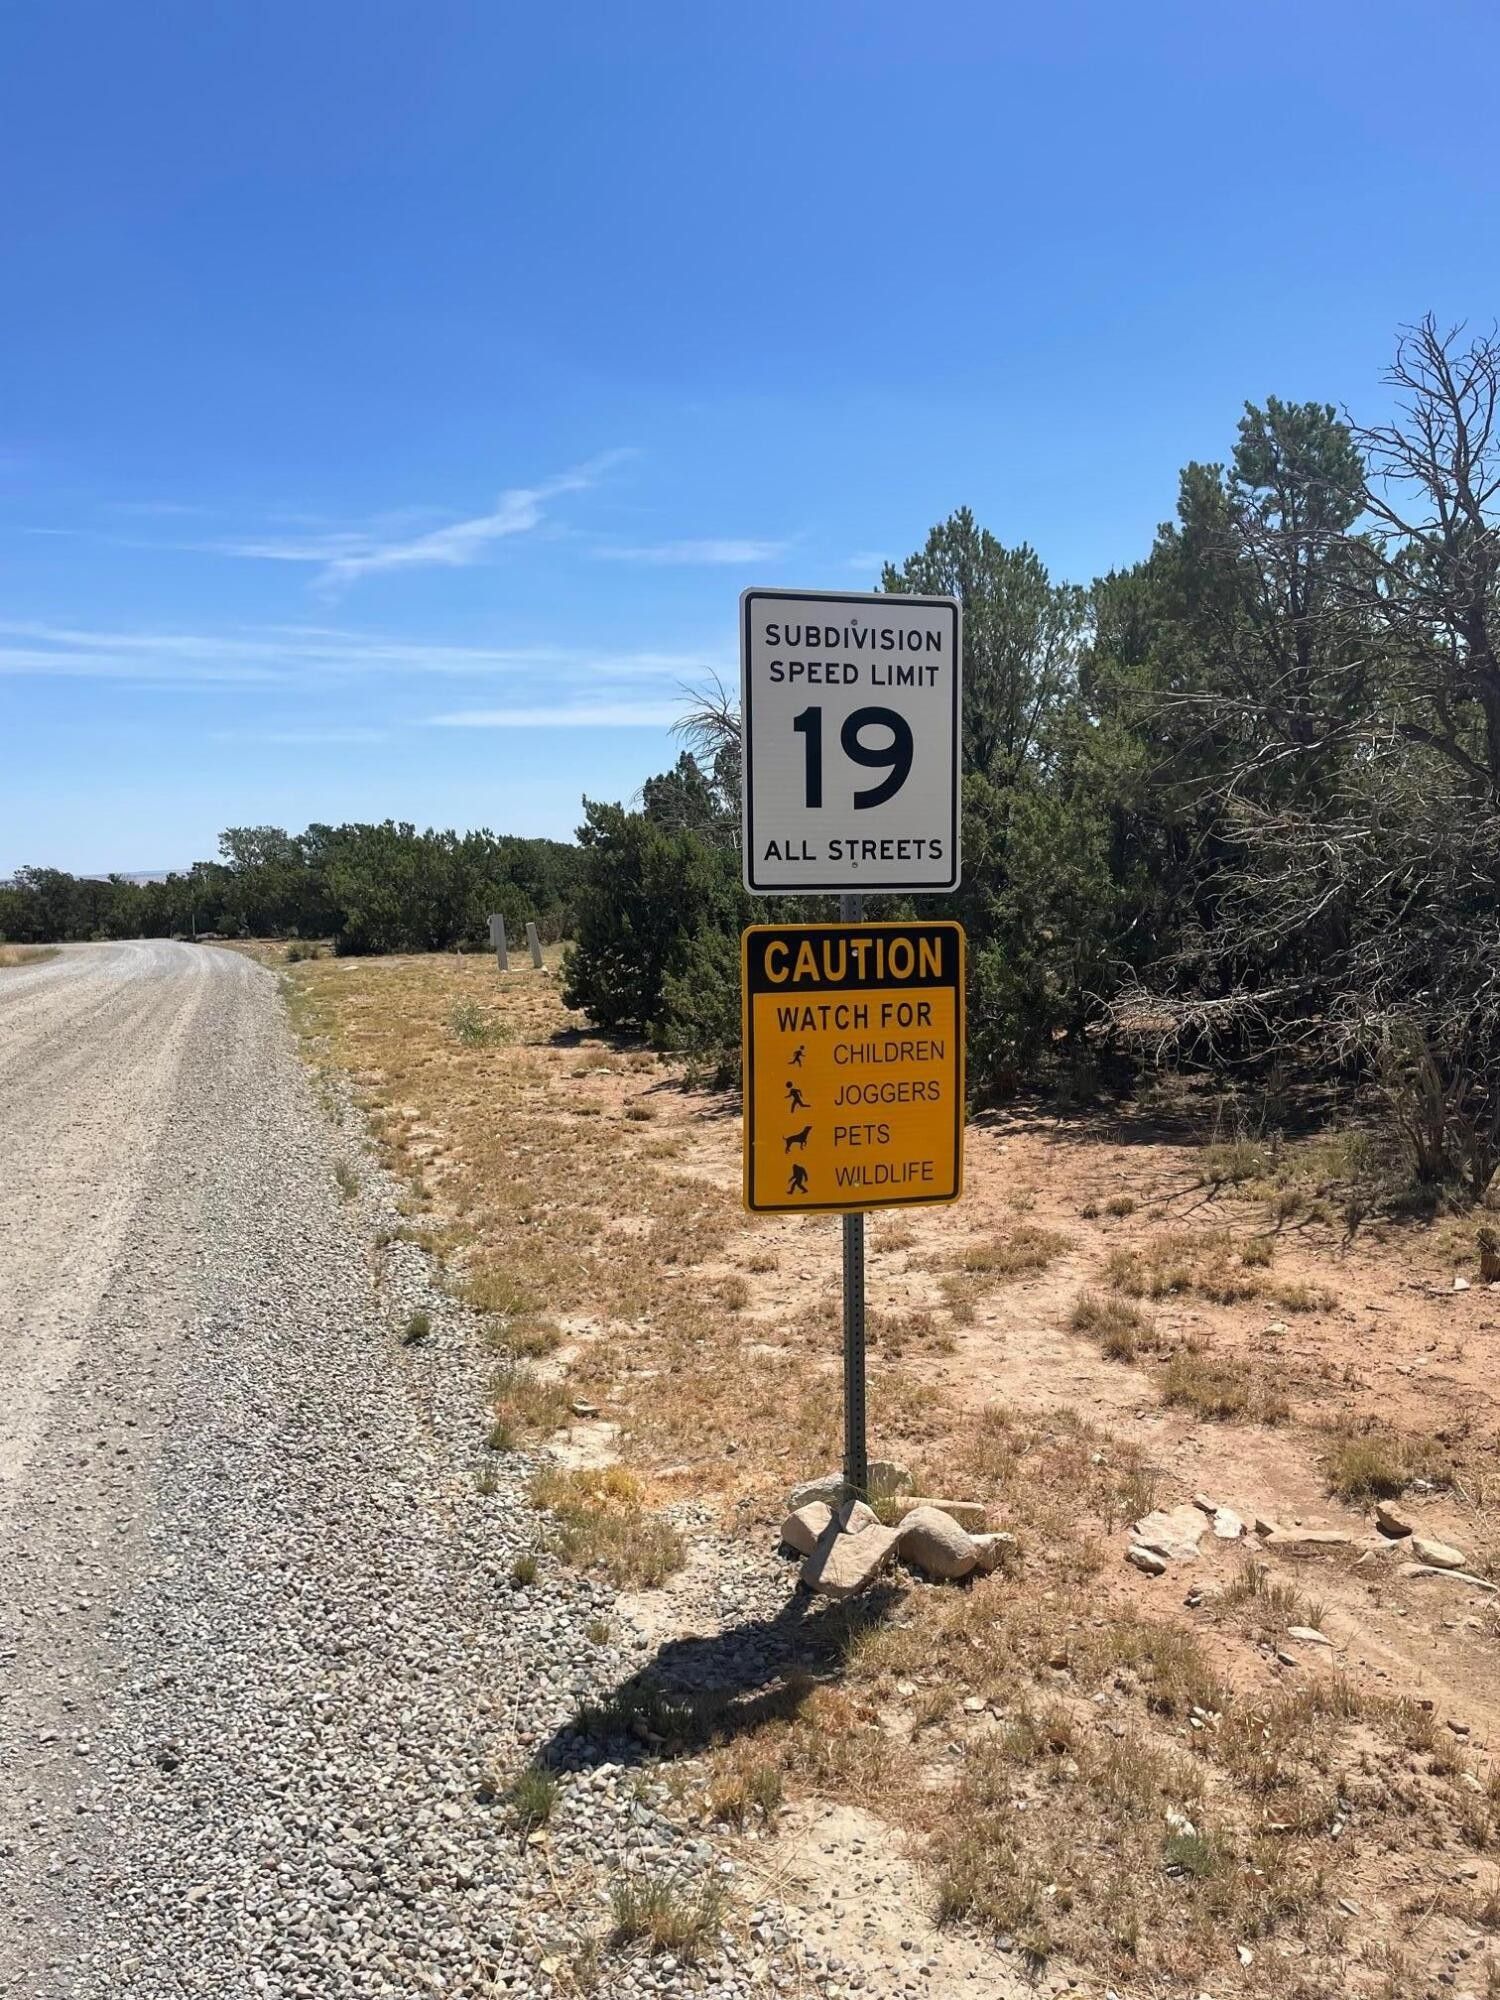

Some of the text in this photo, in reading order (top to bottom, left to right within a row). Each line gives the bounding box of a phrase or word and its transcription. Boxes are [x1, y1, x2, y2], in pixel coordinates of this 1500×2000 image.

[765, 624, 942, 652] SUBDIVISION
[769, 660, 940, 687] SPEED LIMIT
[793, 706, 914, 810] 19
[764, 839, 943, 861] ALL STREETS
[764, 936, 942, 983] CAUTION
[777, 1002, 932, 1032] WATCH FOR
[833, 1040, 945, 1065] CHILDREN
[834, 1080, 940, 1106] JOGGERS
[834, 1124, 890, 1147] PETS
[835, 1161, 934, 1187] WILDLIFE
